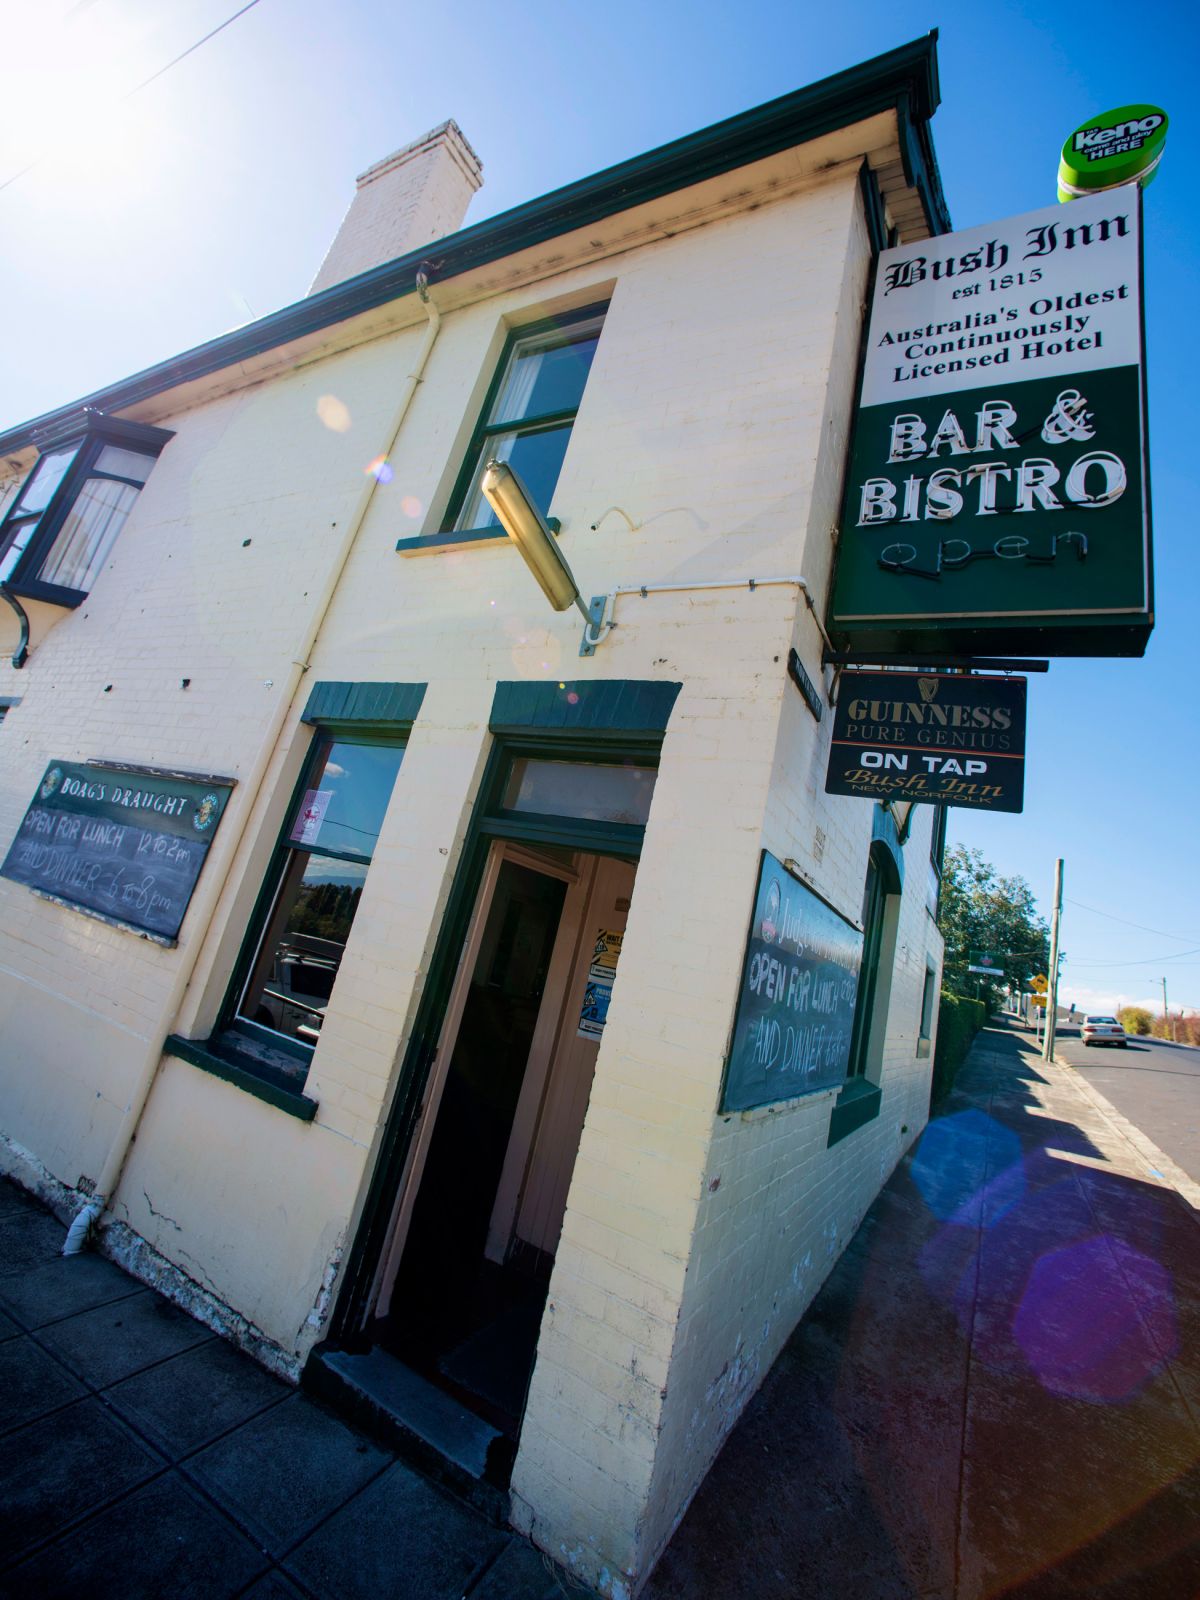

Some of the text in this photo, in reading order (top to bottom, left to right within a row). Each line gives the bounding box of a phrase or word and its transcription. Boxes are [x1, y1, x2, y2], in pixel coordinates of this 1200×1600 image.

[1084, 130, 1153, 153] come and play
[1090, 139, 1142, 160] HERE
[884, 214, 1131, 296] Bush Inn
[951, 268, 1043, 300] est 1815
[878, 284, 1130, 347] Australia's Oldest
[893, 331, 1103, 383] Licensed Hotel
[905, 314, 1091, 360] Continuously
[885, 389, 1096, 464] BAR &
[855, 450, 1127, 527] BISTRO
[880, 532, 1088, 577] open
[848, 699, 1013, 730] GUINNESS
[845, 725, 1011, 750] PURE GENIUS
[844, 769, 1005, 797] Bush Inn
[860, 751, 988, 776] ON TAP
[60, 777, 106, 801] BOAG'S
[112, 787, 188, 816] DRAUGHT
[851, 784, 993, 804] NEW NORFOLK
[25, 810, 55, 834] OPEN
[55, 816, 81, 839] FOR
[82, 820, 125, 848] LUNCH
[137, 832, 153, 854] 12
[42, 850, 101, 891] DINNER
[749, 952, 787, 1004] OPEN
[787, 966, 811, 1013] FOR
[812, 972, 839, 1014] LUNCH
[752, 1016, 781, 1069] AND
[781, 1024, 825, 1074] DINNER
